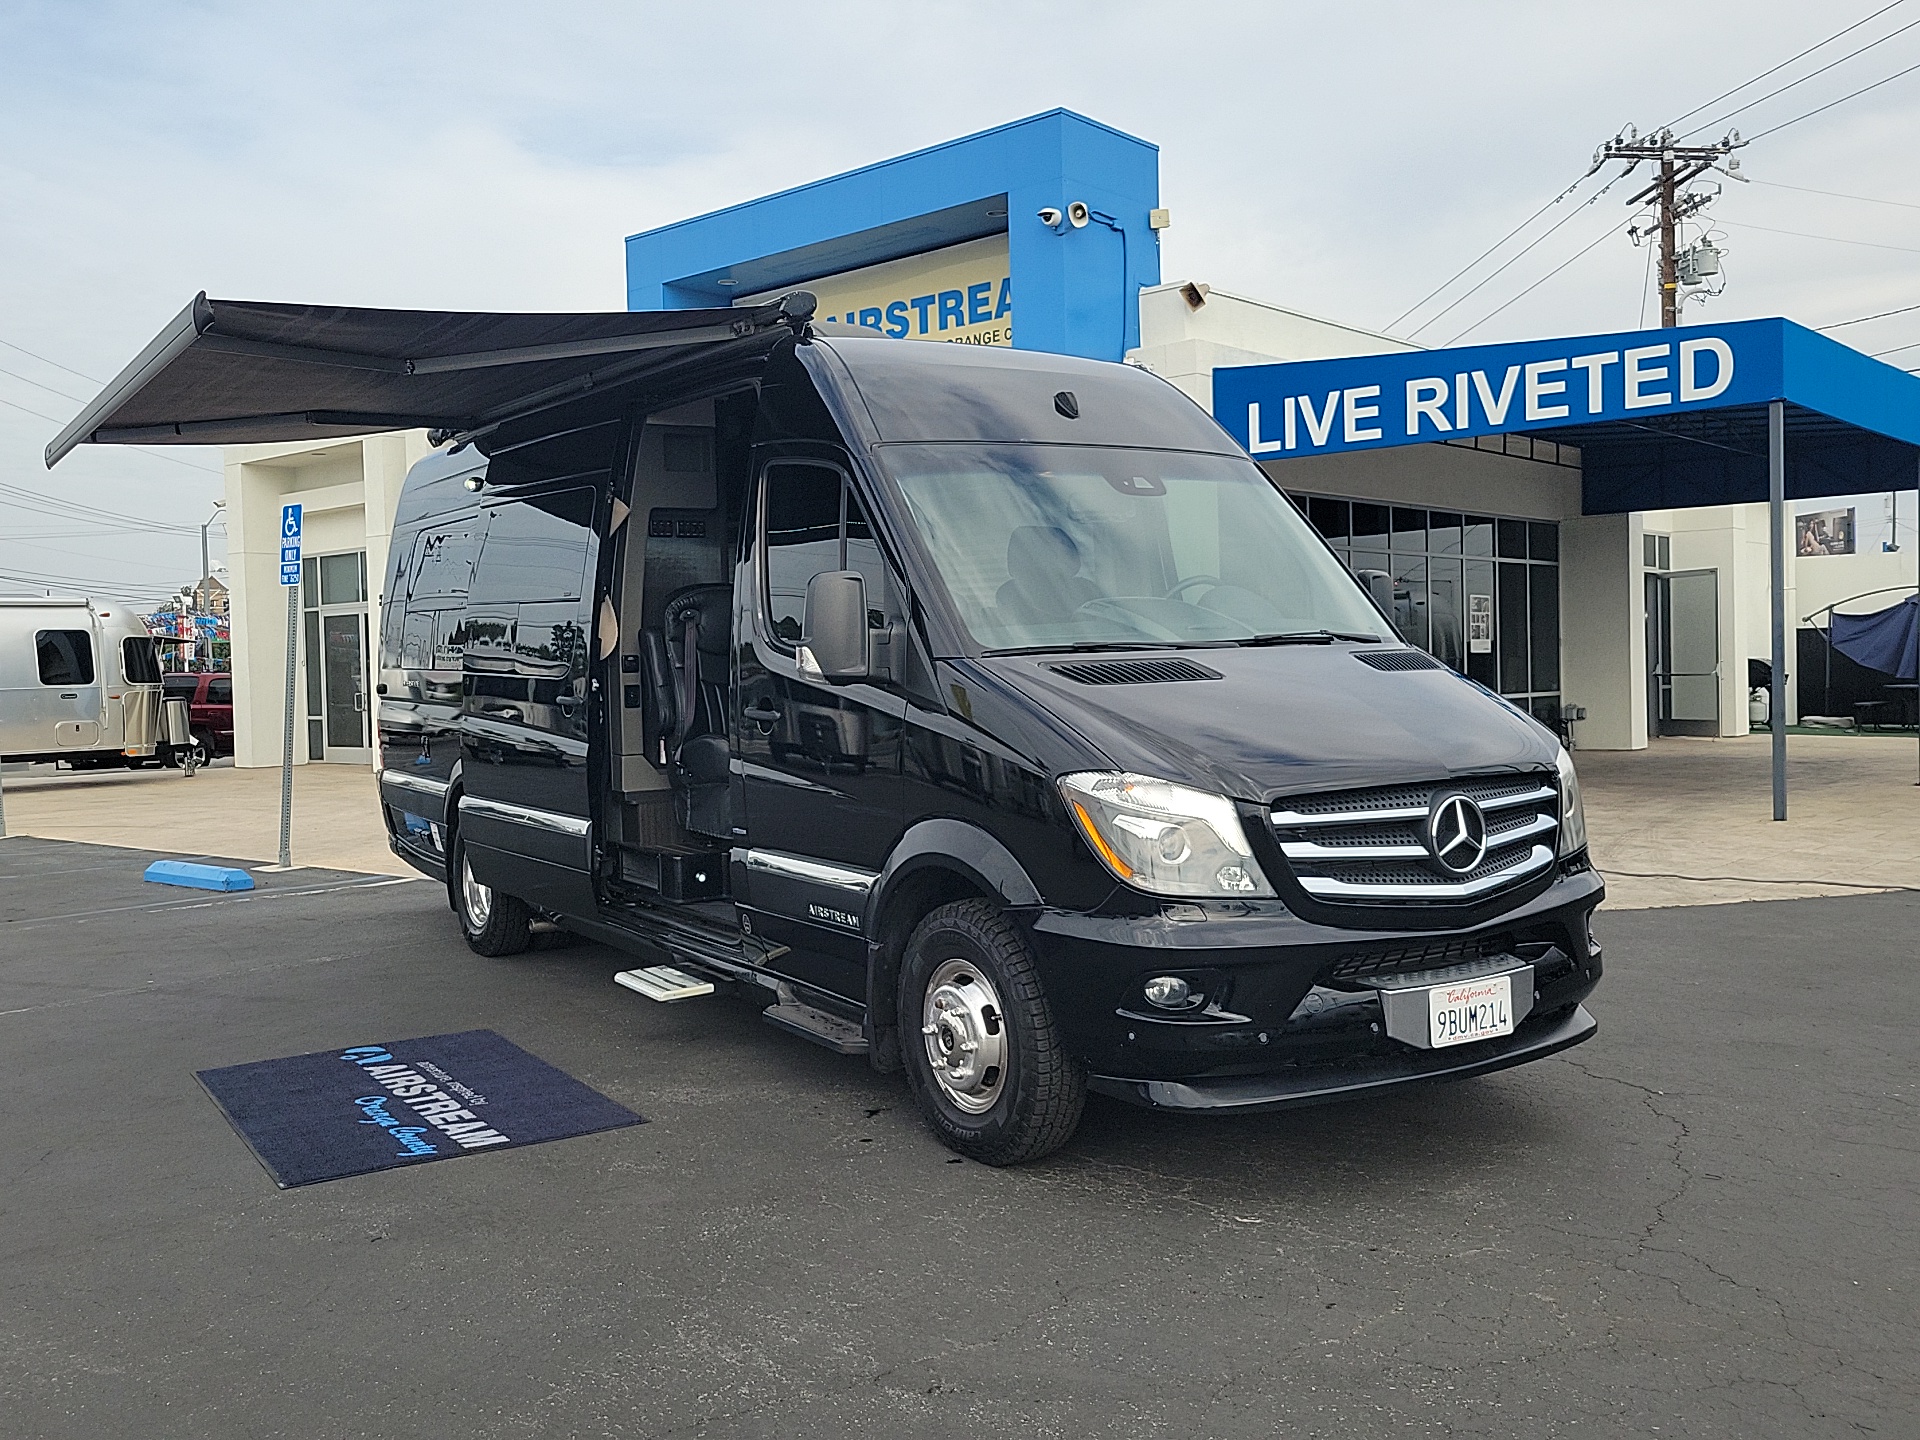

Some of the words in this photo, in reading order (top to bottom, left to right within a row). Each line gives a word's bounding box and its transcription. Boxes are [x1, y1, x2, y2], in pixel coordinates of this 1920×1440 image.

[826, 277, 1012, 340] RSTREA
[946, 330, 1000, 345] RANGE
[1247, 384, 1383, 454] LIVE
[1405, 336, 1735, 436] RIVETED
[285, 549, 297, 561] ONLY
[808, 903, 860, 928] AIRSTREAM
[1446, 986, 1497, 1005] California
[1437, 999, 1508, 1039] 9BUM214
[1452, 1029, 1494, 1041] dmv.ca.gov
[362, 1063, 511, 1149] AIRSTREAM
[354, 1095, 400, 1128] Orange
[388, 1126, 438, 1157] County
